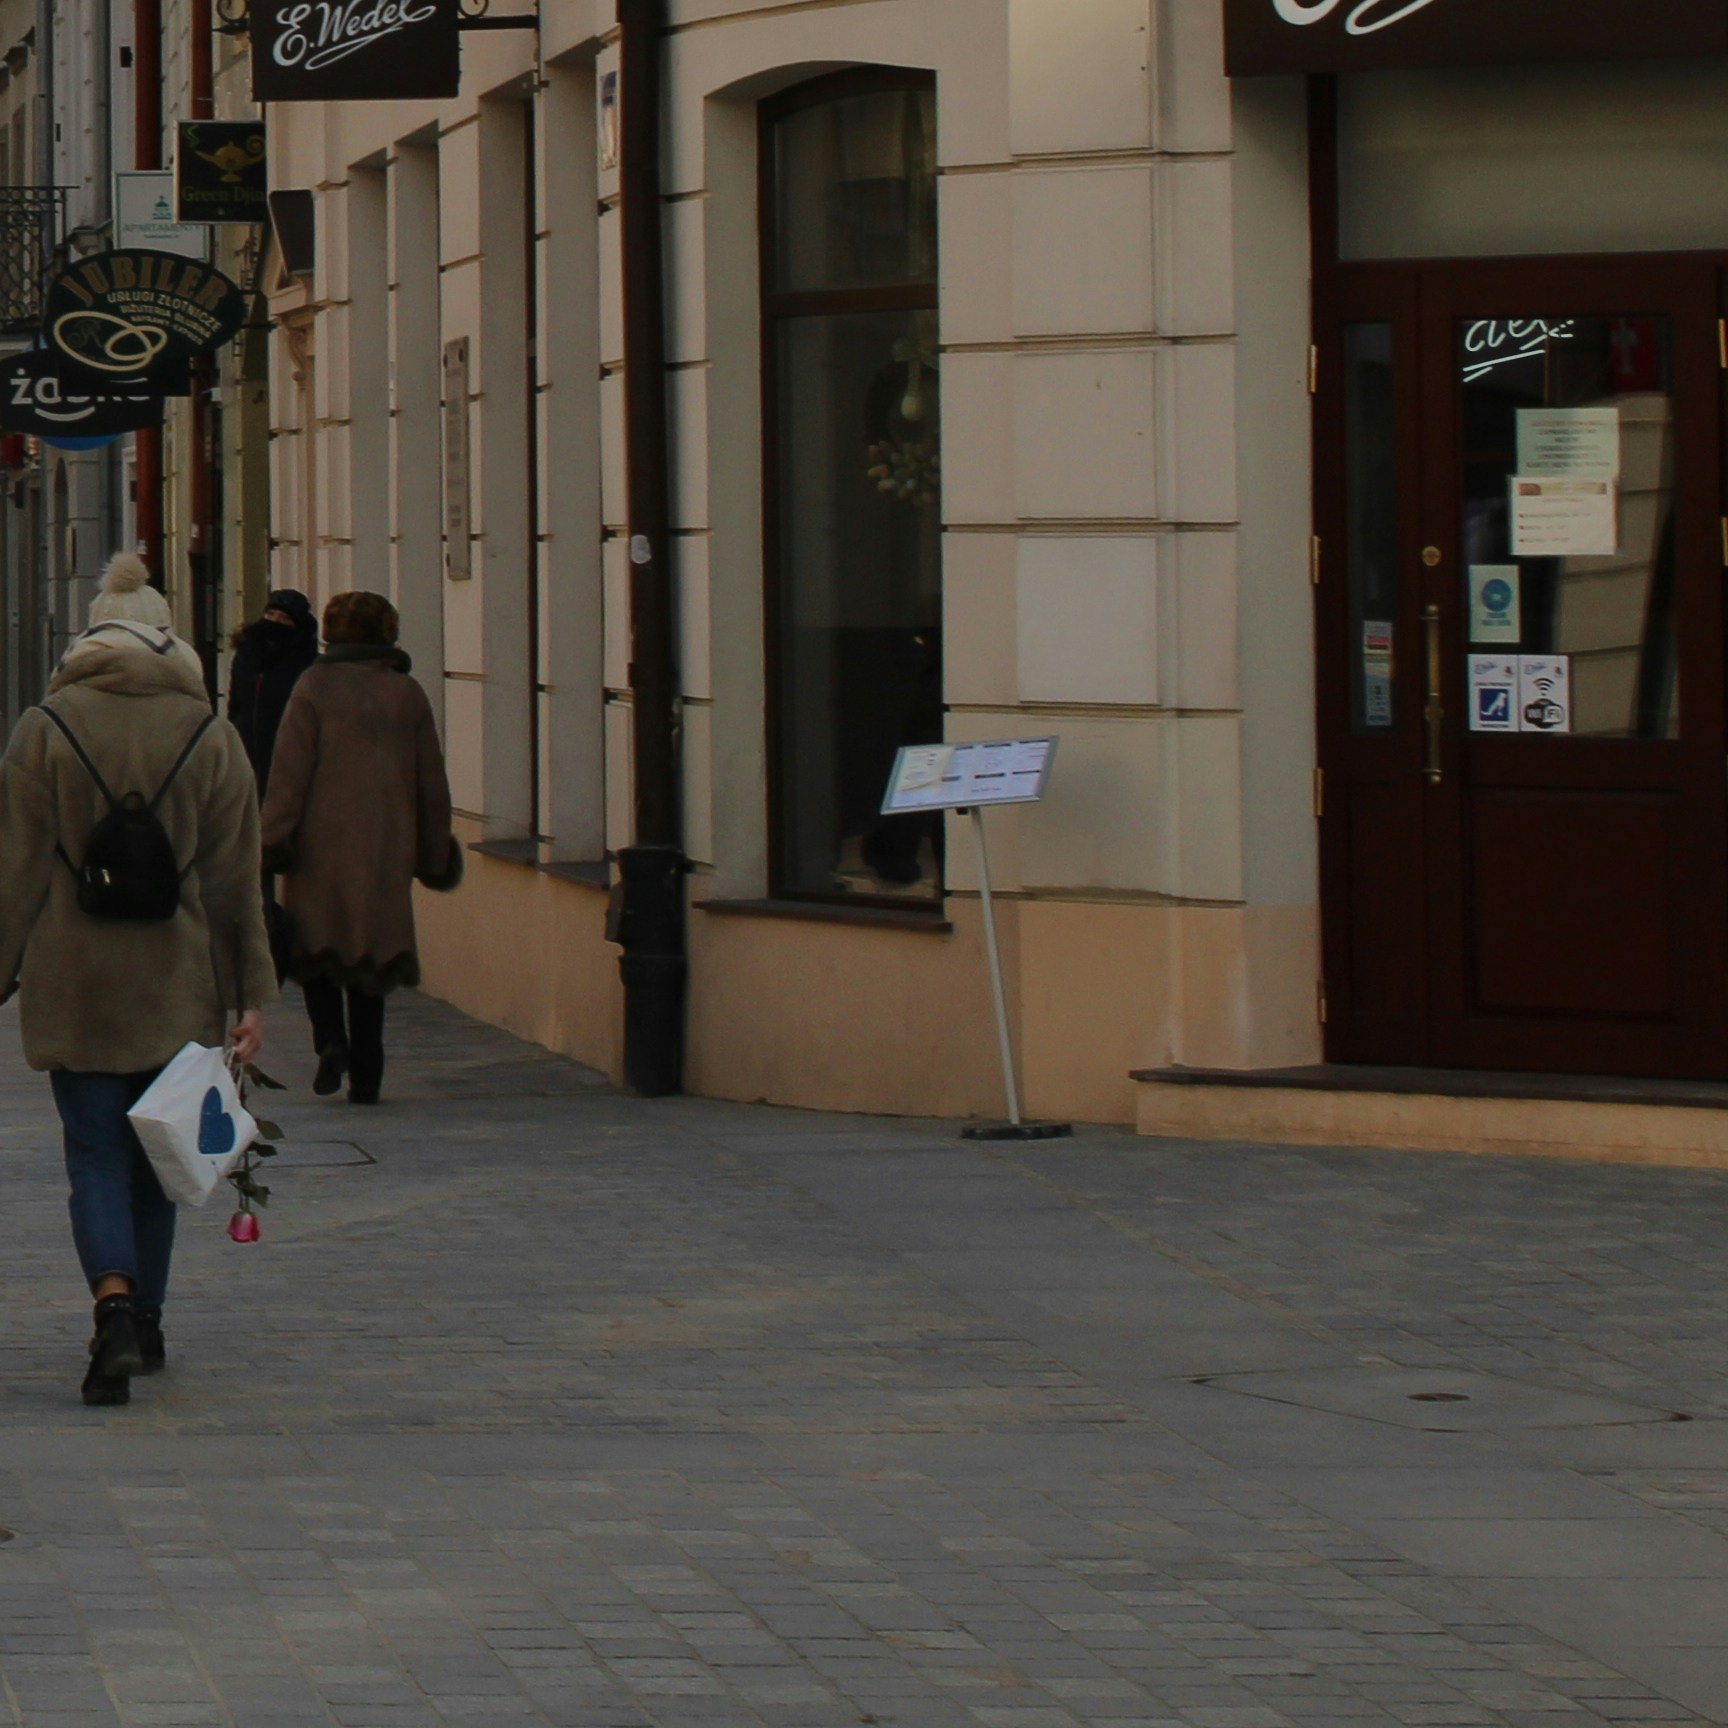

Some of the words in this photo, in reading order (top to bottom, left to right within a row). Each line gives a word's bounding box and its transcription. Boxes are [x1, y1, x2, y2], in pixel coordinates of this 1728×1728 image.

[183, 186, 228, 202] Green
[61, 256, 228, 309] JUBILER
[107, 290, 154, 303] USŁUGI
[158, 293, 224, 332] ZŁOTNICZE
